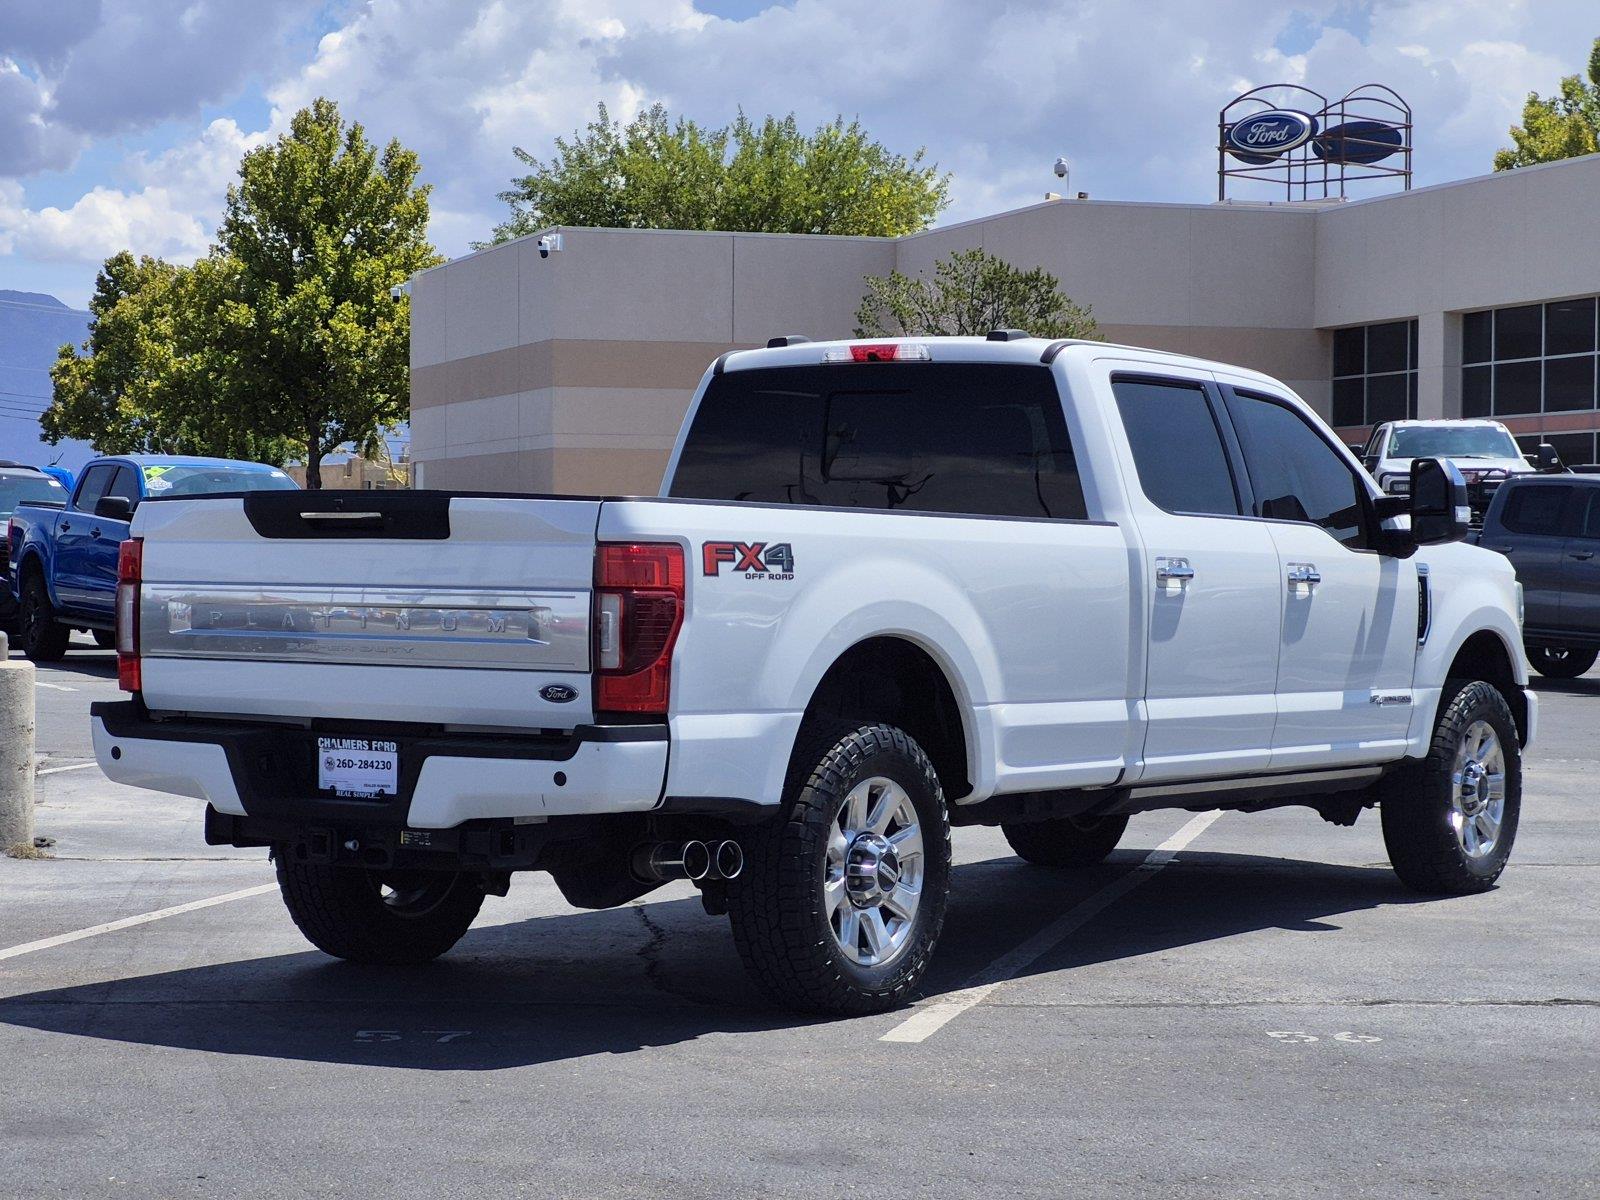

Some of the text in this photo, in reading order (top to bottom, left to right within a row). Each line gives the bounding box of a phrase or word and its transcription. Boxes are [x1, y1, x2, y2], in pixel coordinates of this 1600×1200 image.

[1246, 121, 1289, 144] Ford
[702, 540, 794, 577] FX4
[208, 609, 506, 633] PLATINUM
[546, 687, 568, 699] Ford
[318, 737, 397, 752] CHALMERS FORD
[336, 758, 392, 770] 26D-284230
